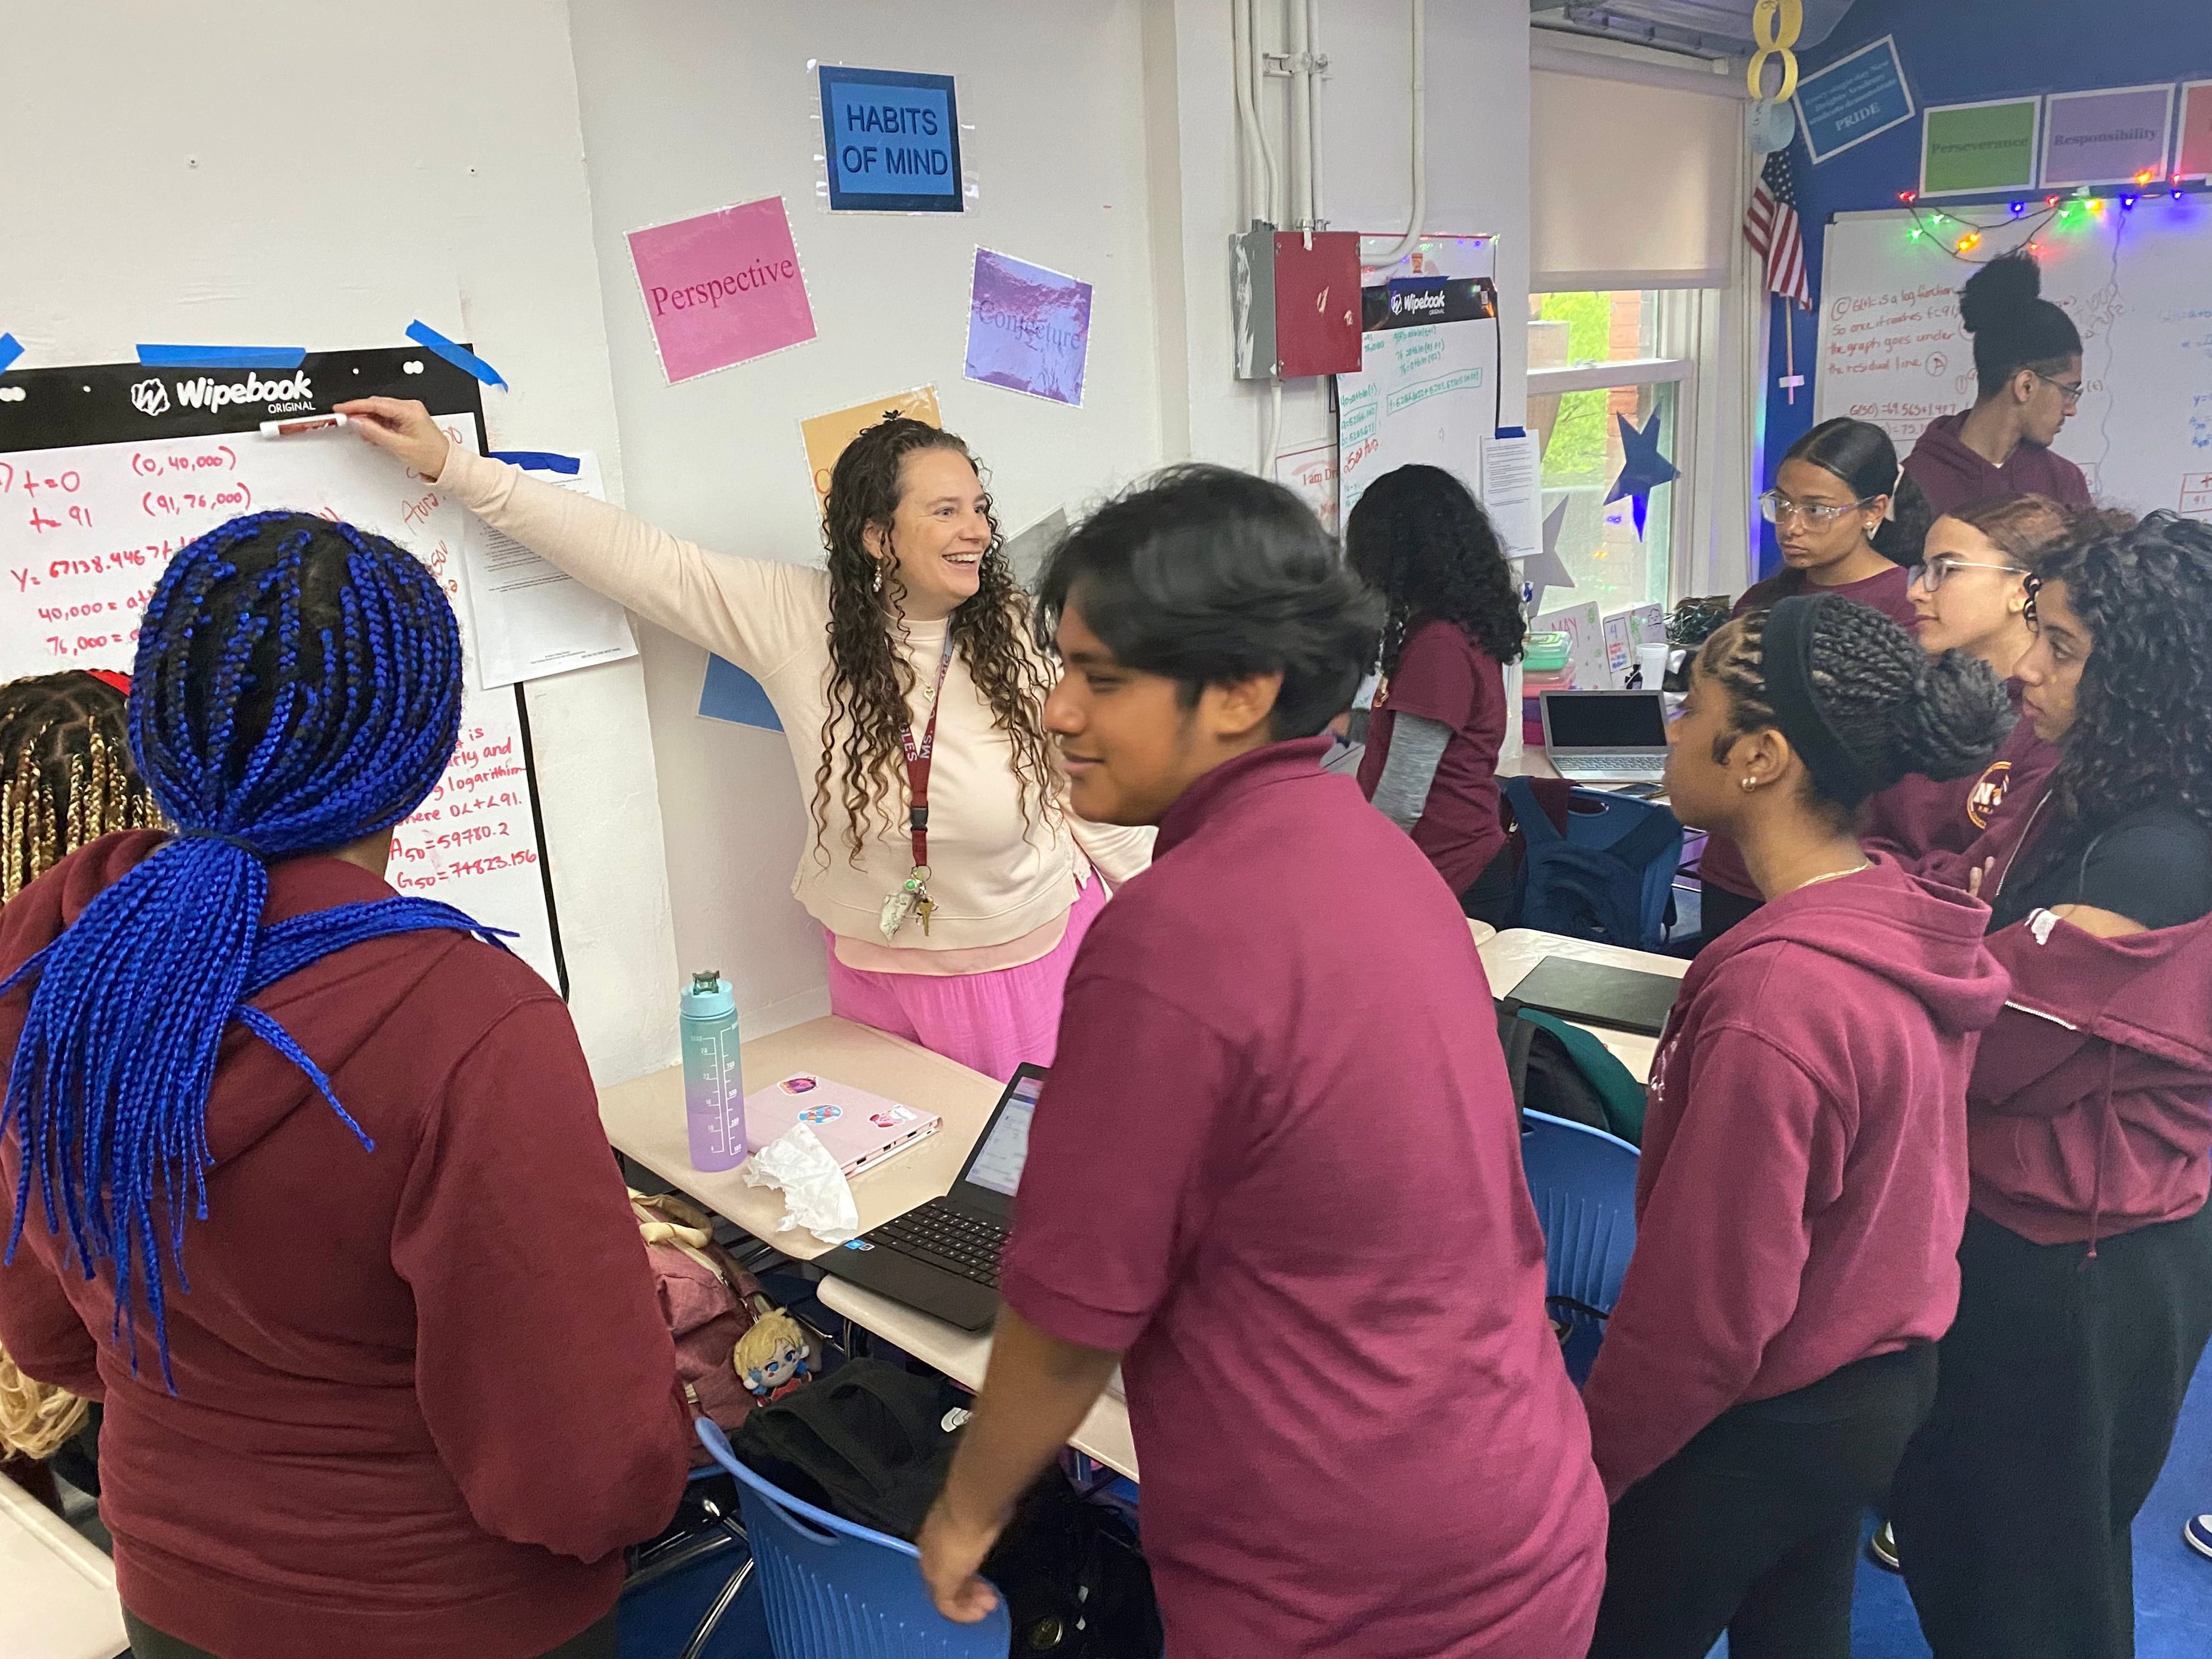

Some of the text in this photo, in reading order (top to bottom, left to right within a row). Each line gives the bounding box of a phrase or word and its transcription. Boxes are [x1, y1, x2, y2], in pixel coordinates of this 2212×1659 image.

[846, 104, 938, 136] HABITS
[1834, 102, 1881, 131] PRIDE
[1930, 138, 2029, 155] Perseverance
[2054, 127, 2156, 146] Responsibility
[842, 145, 949, 175] OF MIND
[650, 258, 794, 315] Perspective
[1404, 290, 1446, 315] Wipebook
[978, 300, 1081, 349] Conjecture
[176, 370, 314, 414] Wipebook
[268, 400, 316, 415] ORIGINAL
[1309, 473, 1323, 484] am
[468, 727, 484, 741] is
[483, 736, 511, 758] and
[728, 1088, 737, 1097] 500
[731, 1117, 740, 1126] 300
